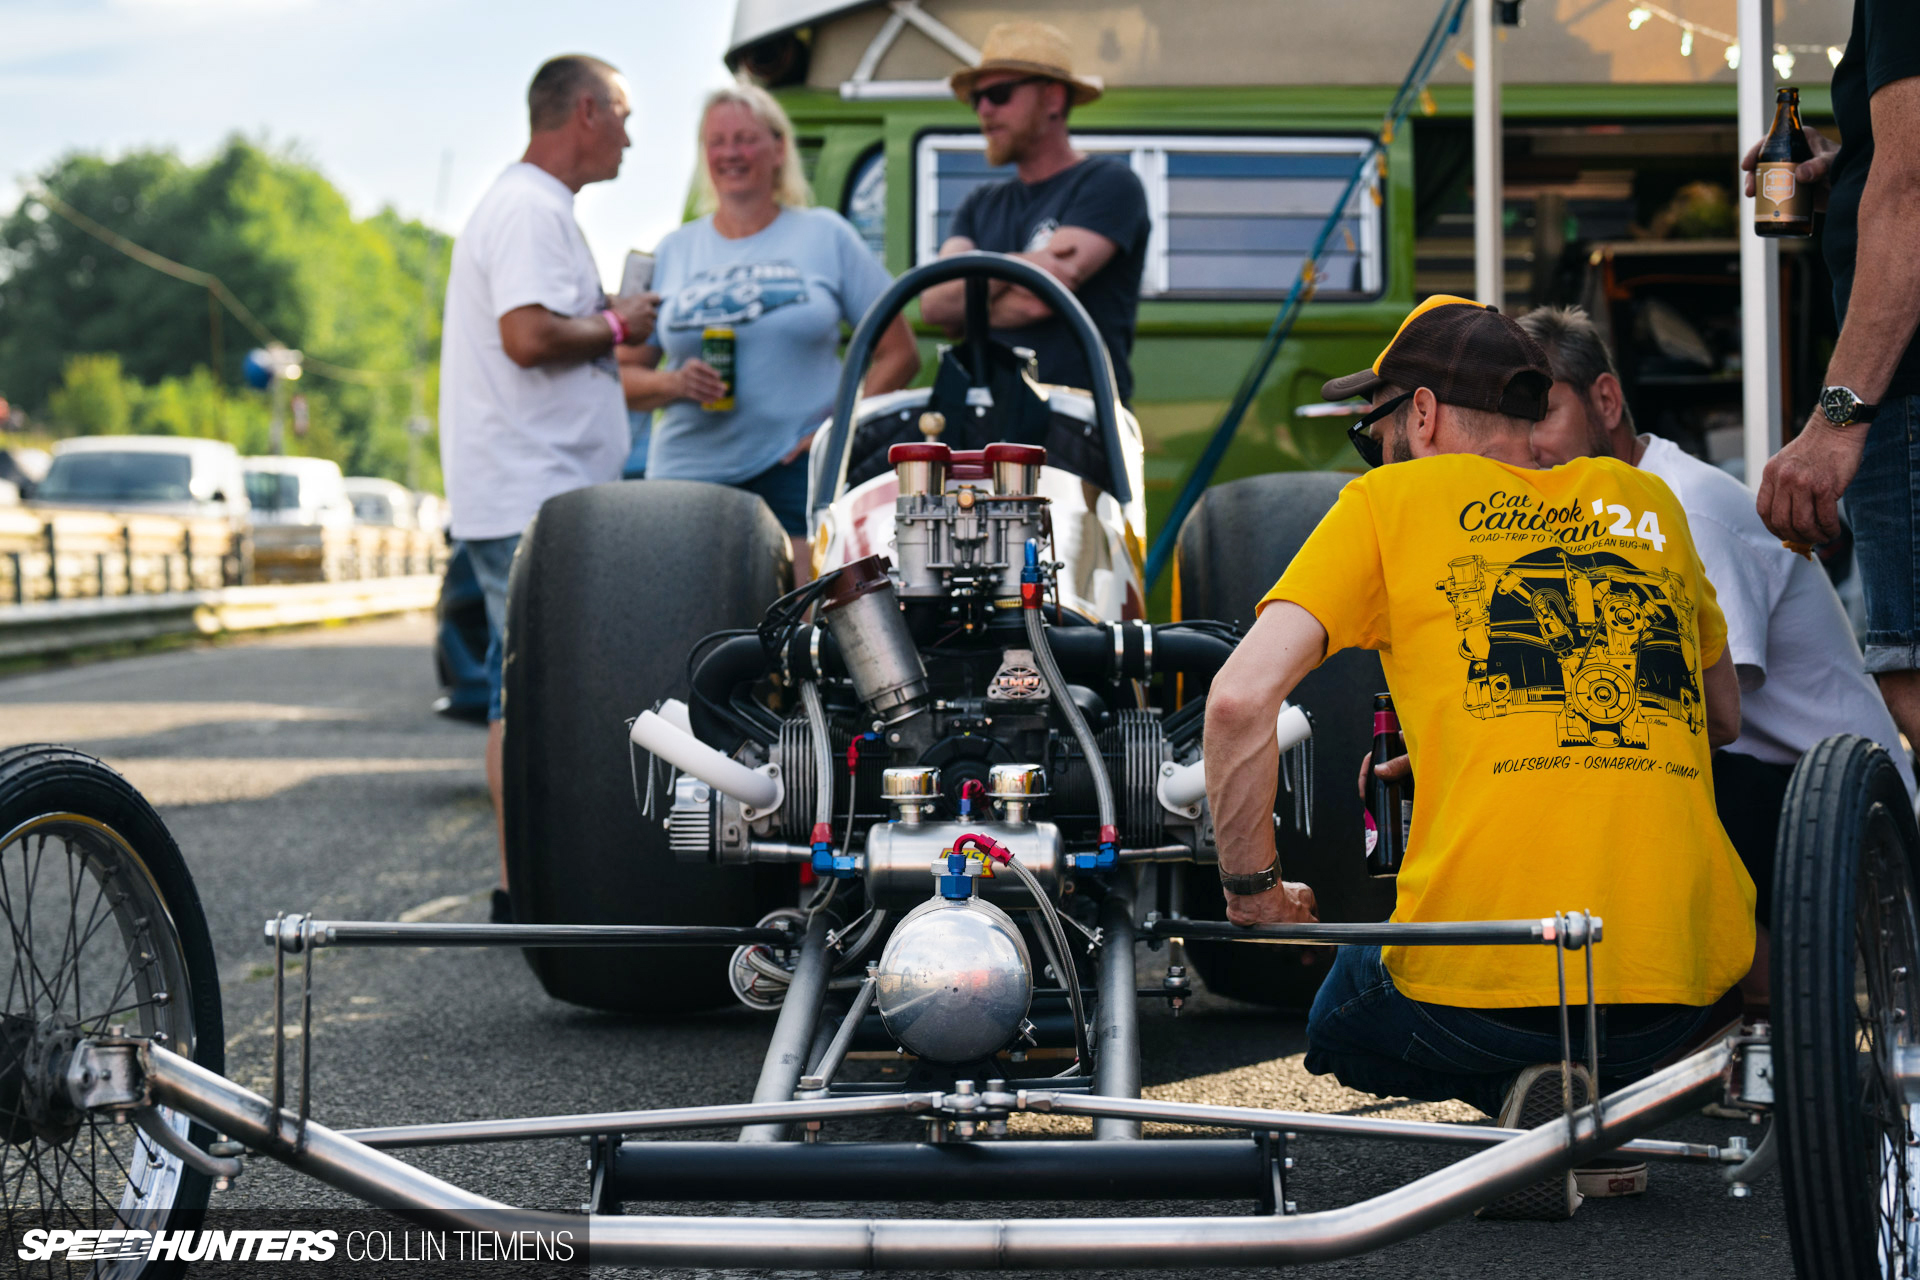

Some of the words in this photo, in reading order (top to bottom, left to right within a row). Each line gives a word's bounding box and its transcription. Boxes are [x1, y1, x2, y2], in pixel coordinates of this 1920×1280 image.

[1591, 498, 1667, 552] '24
[1469, 532, 1529, 543] ROAD-TRIP
[1531, 533, 1546, 543] TO
[1619, 539, 1650, 552] BUG-IN
[1493, 755, 1571, 775] WOLFSBURG
[1583, 756, 1657, 772] OSNABRÜCK
[1665, 761, 1700, 781] CHIMAY
